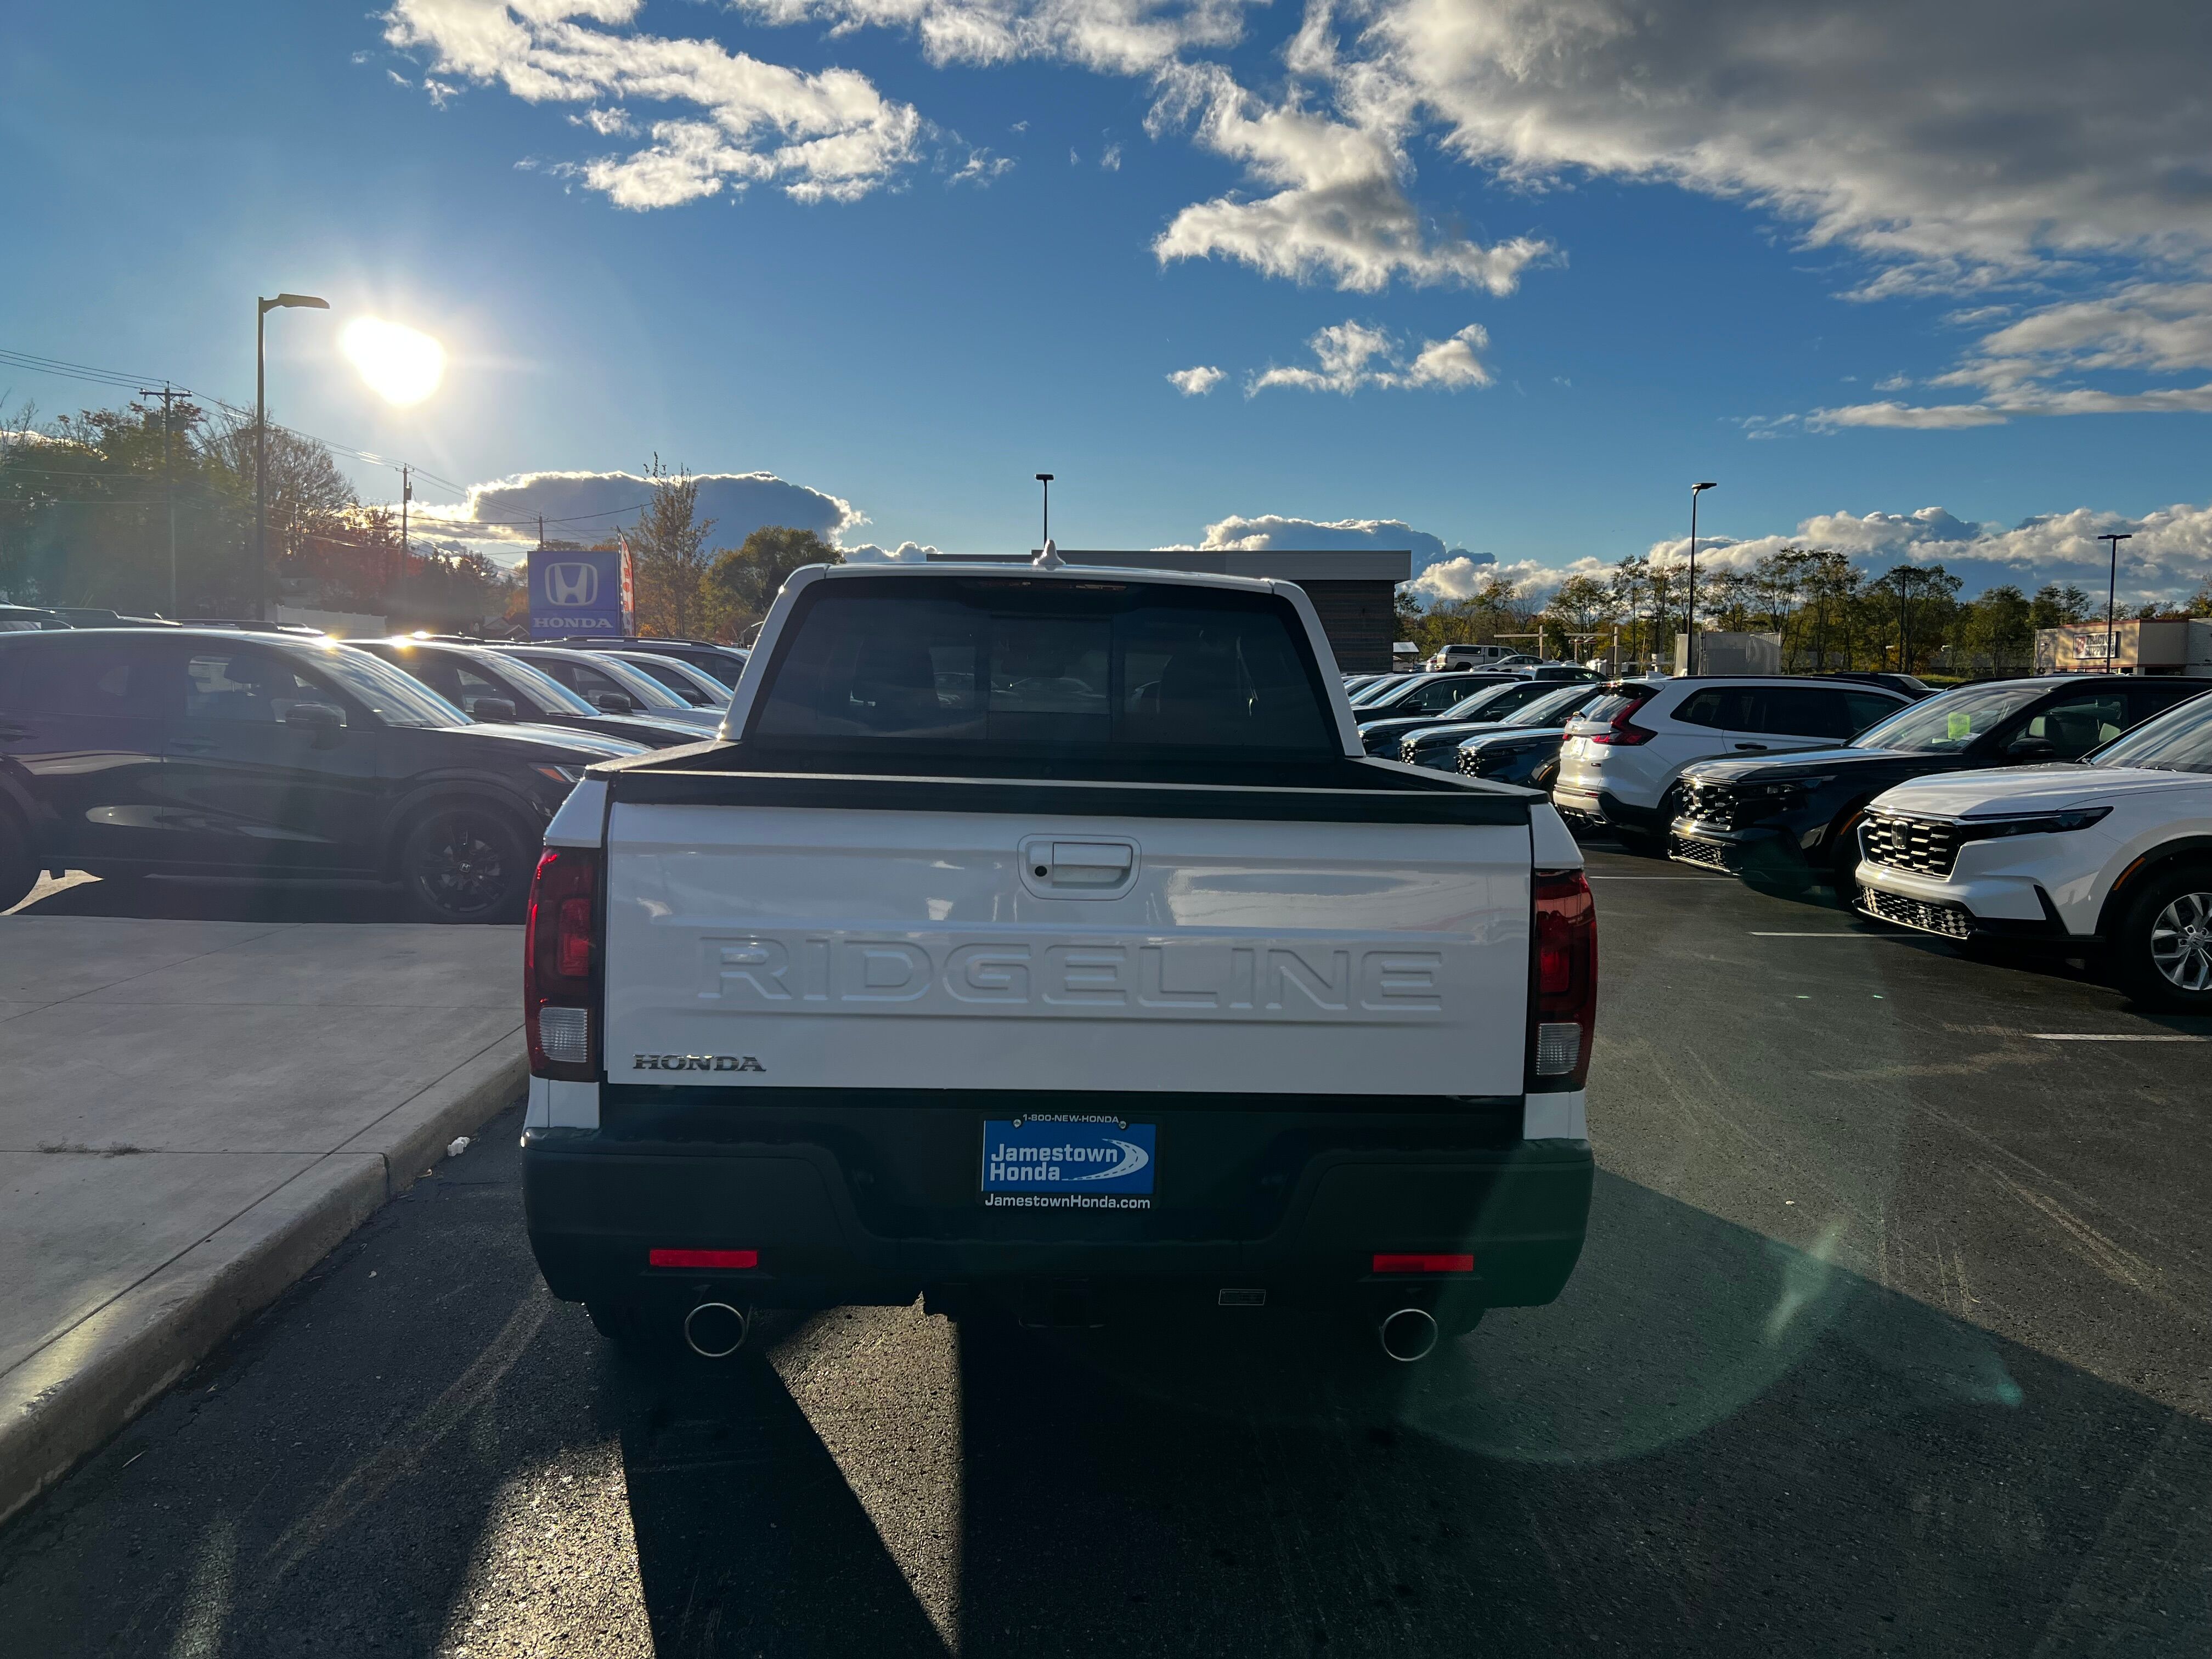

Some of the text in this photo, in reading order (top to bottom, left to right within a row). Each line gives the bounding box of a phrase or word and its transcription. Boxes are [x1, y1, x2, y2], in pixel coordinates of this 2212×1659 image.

[532, 617, 614, 629] HONDA
[698, 936, 1442, 1010] RIDGELINE
[633, 1053, 767, 1072] HONDA
[1022, 1113, 1119, 1124] 1-800-NEW-HONDA
[991, 1143, 1118, 1163] Jamestown
[990, 1162, 1060, 1181] Honda
[985, 1193, 1150, 1209] JamestownHonda.com
